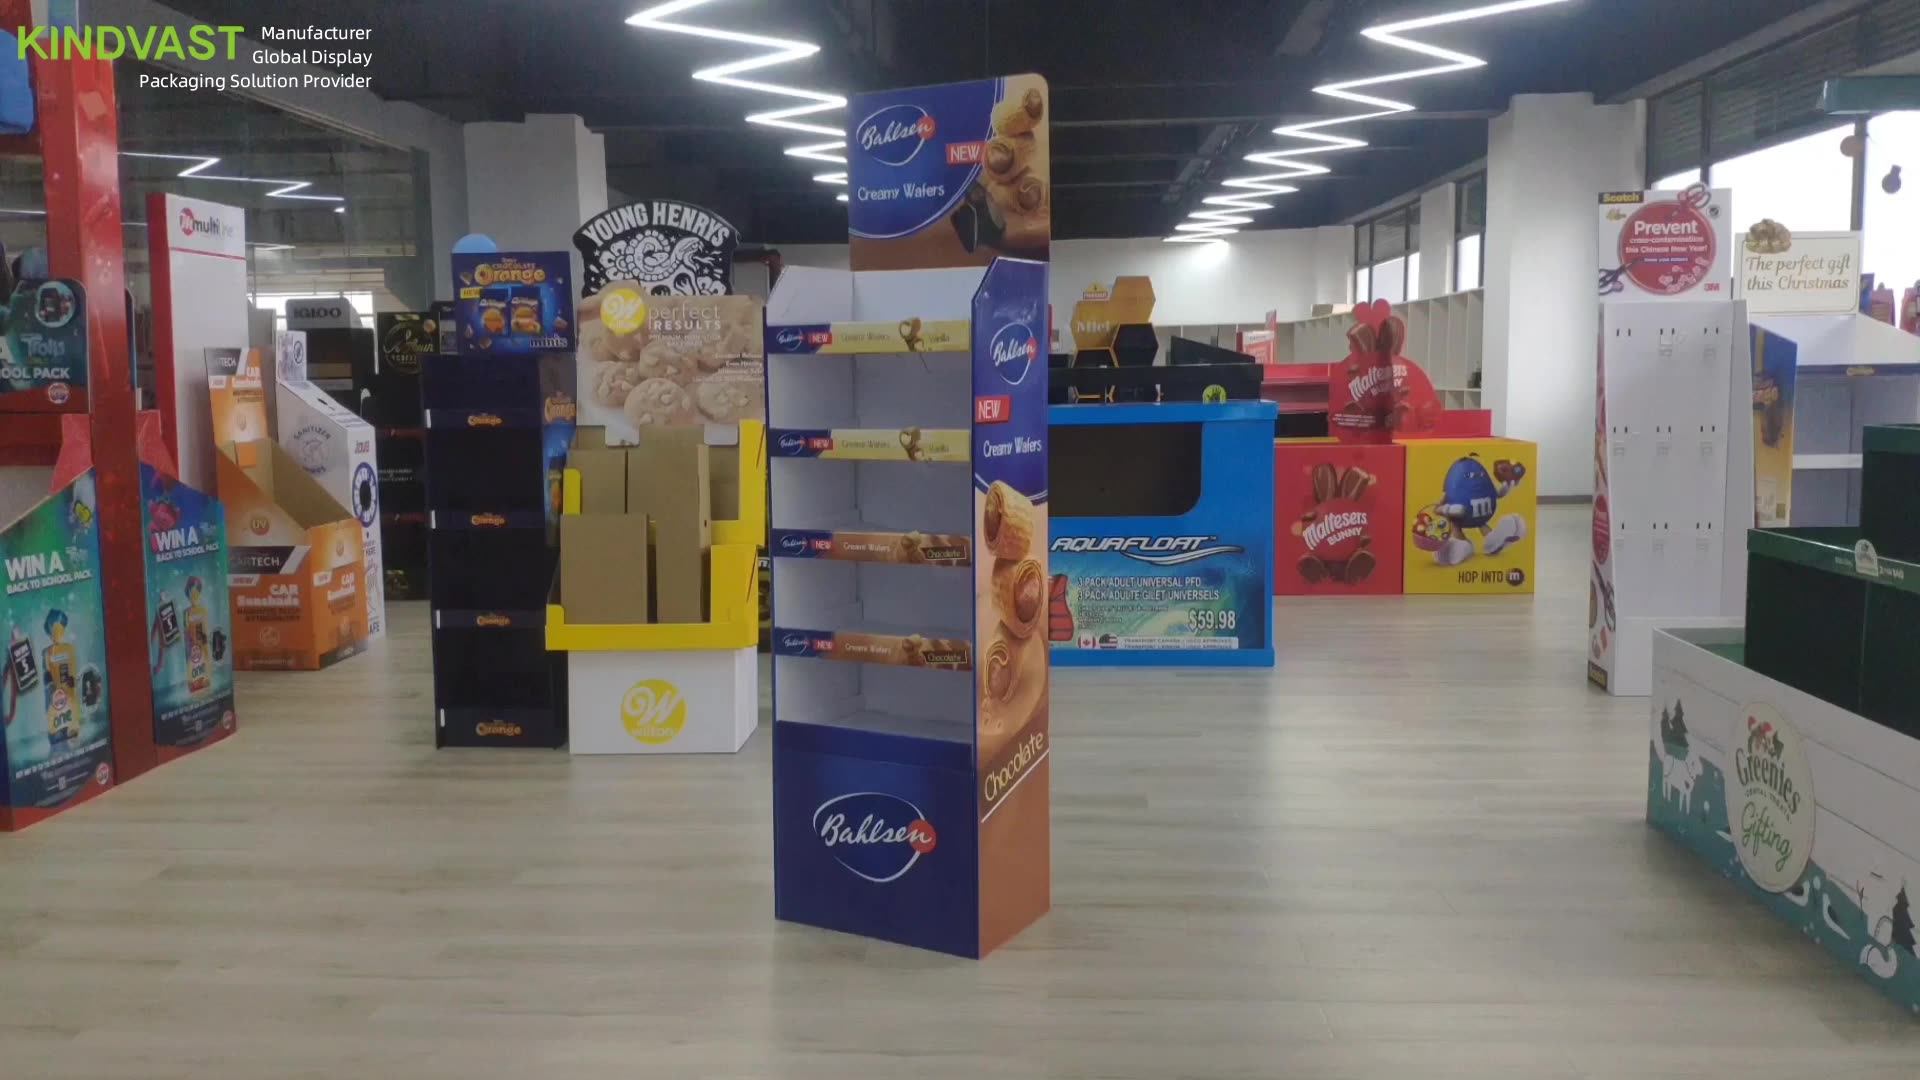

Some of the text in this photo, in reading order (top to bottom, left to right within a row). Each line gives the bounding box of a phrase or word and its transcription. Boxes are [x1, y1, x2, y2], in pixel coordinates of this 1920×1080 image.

[861, 120, 932, 150] Bahlsen
[950, 145, 980, 162] NEW
[857, 182, 945, 201] Creamy Wafers
[1603, 193, 1640, 202] Scotch
[582, 201, 730, 247] YOUNG HENRYS
[1634, 220, 1698, 235] Prevent
[1641, 245, 1669, 253] Chinese
[474, 263, 546, 285] Orange
[1746, 253, 1850, 276] The perfect gift
[1704, 283, 1720, 291] 3M
[1747, 274, 1849, 290] this Christmas
[648, 302, 720, 328] perfect
[654, 320, 721, 331] RESULTS
[812, 335, 828, 343] NEW
[993, 338, 1036, 366] Bahlsen
[33, 367, 70, 379] PACK
[977, 400, 1001, 420] NEW
[813, 440, 829, 448] NEW
[983, 437, 1042, 457] Creamy Wafers
[154, 527, 186, 552] WIN
[187, 525, 199, 546] A
[1302, 511, 1367, 550] Maltesers
[1327, 526, 1362, 545] BUNNY
[815, 541, 831, 549] NEW
[1050, 536, 1208, 552] AQUAFLOAT
[5, 552, 46, 582] WIN
[49, 551, 65, 574] A
[1086, 577, 1107, 587] PACK
[1109, 577, 1134, 587] ADULT
[1138, 577, 1182, 587] UNIVERSAL
[1185, 577, 1200, 587] PFD
[1458, 571, 1478, 583] HOP
[1481, 571, 1504, 583] INTO
[270, 584, 299, 595] CAR
[1086, 590, 1107, 600] PACK
[1109, 590, 1140, 600] ADULTE
[1169, 590, 1219, 600] UNIVERSELS
[1189, 608, 1236, 631] $59.98
[984, 731, 1044, 801] Chocolate
[1736, 747, 1800, 815] Greenies
[820, 813, 932, 847] Bahlsen
[1741, 801, 1793, 872] Gifting
